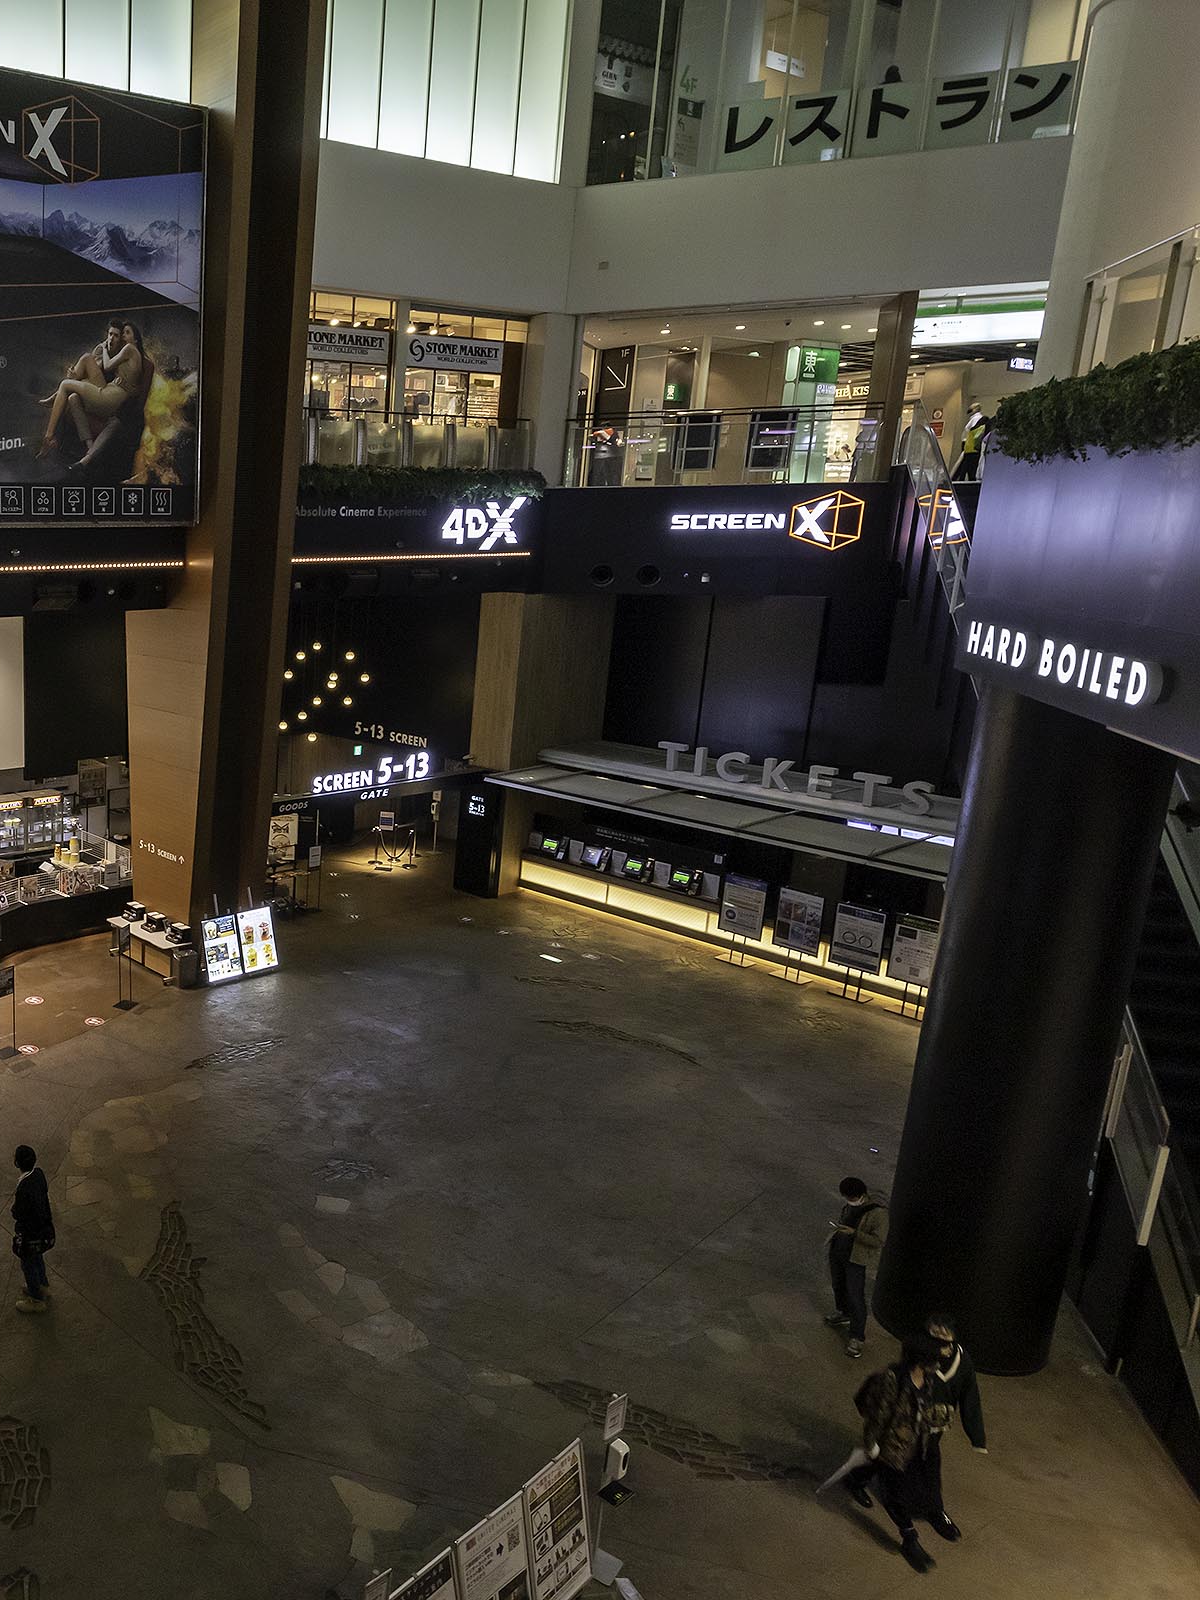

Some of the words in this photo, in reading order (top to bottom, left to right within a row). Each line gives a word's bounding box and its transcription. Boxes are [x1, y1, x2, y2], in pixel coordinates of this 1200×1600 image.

[724, 72, 1072, 154] レストラン
[308, 331, 337, 345] TONE
[338, 334, 385, 348] MARKET
[426, 342, 458, 354] STONE
[459, 345, 499, 358] MARKET
[621, 348, 631, 358] 1F
[803, 350, 818, 372] 東
[295, 506, 337, 517] Absolute
[339, 506, 374, 517] Cinema
[377, 506, 428, 518] Experience
[442, 496, 527, 550] 4DX
[671, 513, 786, 530] SCREEN
[967, 620, 1027, 668] HARD
[1038, 638, 1147, 706] BOILED
[354, 721, 384, 740] 5-13
[389, 731, 427, 748] SCREEN
[313, 770, 373, 794] SCREEN
[378, 752, 430, 784] 5-13
[658, 741, 935, 815] TICKETS
[360, 788, 389, 800] GATE
[279, 801, 308, 813] GOODS
[139, 840, 155, 853] 5-13
[157, 849, 177, 862] SCREEN
